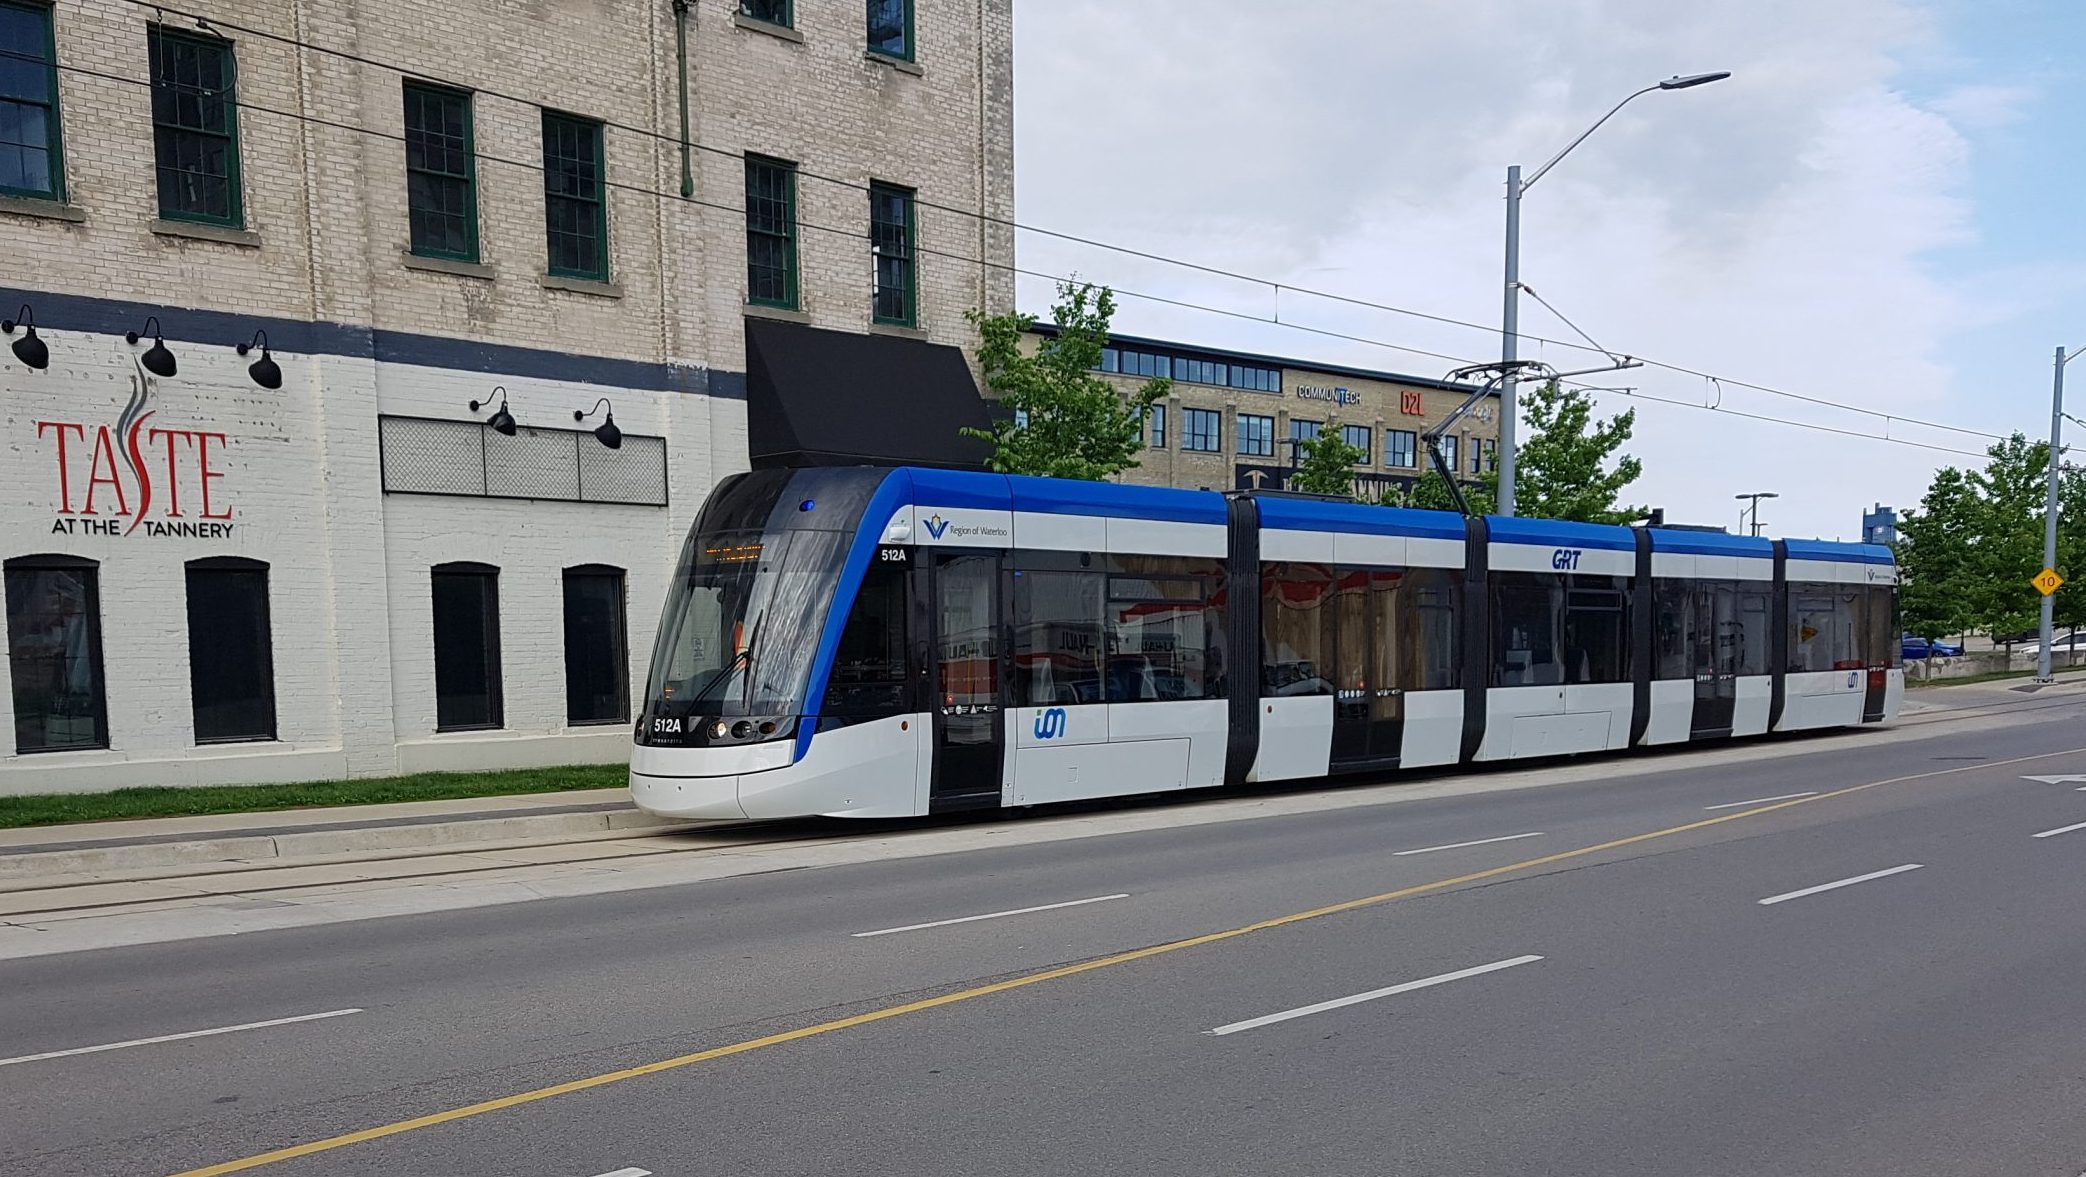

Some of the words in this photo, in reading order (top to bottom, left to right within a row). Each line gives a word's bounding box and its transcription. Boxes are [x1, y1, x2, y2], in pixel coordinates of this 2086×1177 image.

[1297, 385, 1362, 406] COMMUNITECH
[1401, 391, 1425, 416] D2L
[37, 410, 233, 536] TASTE
[52, 518, 77, 535] AT
[80, 519, 121, 536] THE
[143, 521, 234, 538] TANNERY
[950, 525, 972, 537] Region
[972, 525, 979, 535] of
[980, 526, 1008, 537] Waterloo
[881, 549, 907, 561] 512A
[1552, 549, 1582, 570] GRT
[2040, 576, 2056, 588] 10
[654, 718, 682, 733] 512A
